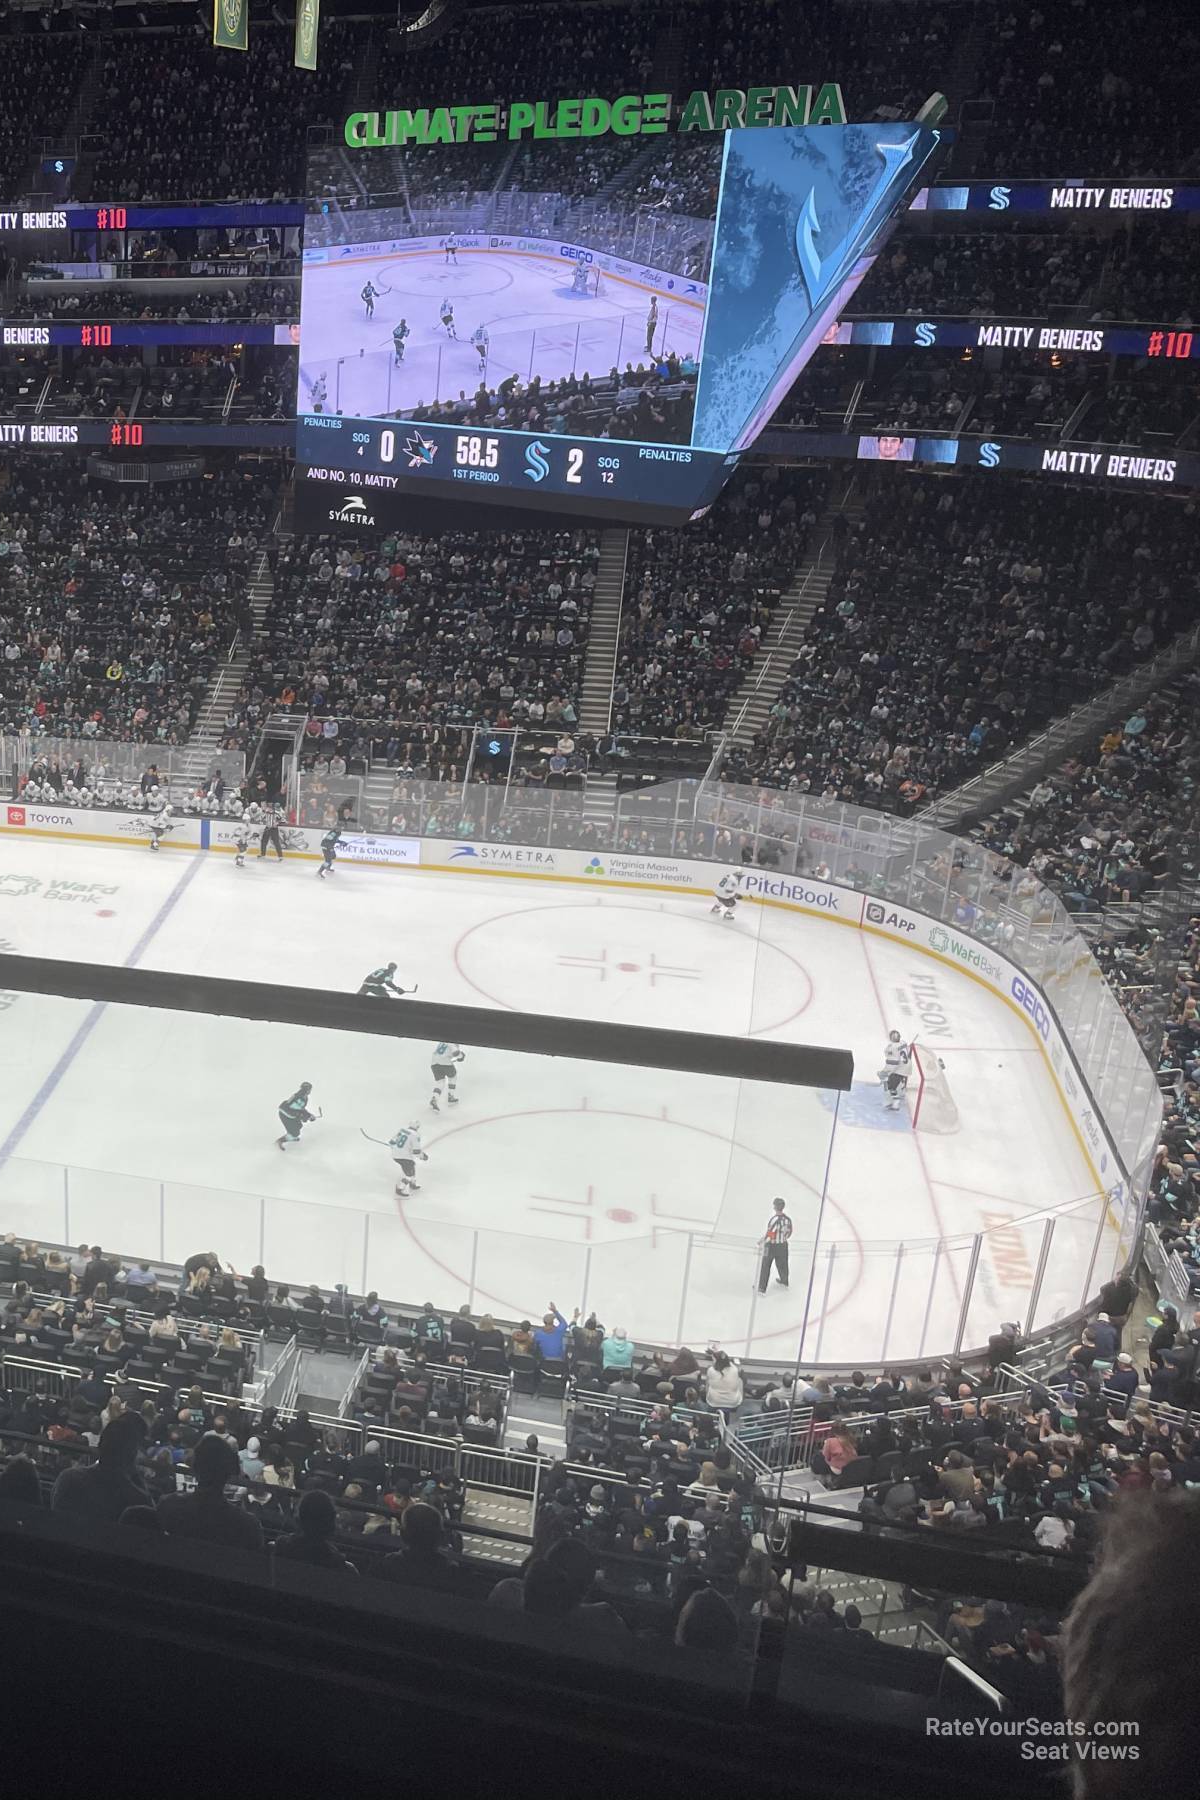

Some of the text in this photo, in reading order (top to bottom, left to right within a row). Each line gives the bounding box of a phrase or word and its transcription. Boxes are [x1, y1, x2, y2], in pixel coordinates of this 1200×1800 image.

[345, 82, 847, 147] CLIMATE PLEDGE ARENA
[1050, 187, 1173, 209] MATTY BENIERS
[22, 211, 67, 229] BENIERS
[96, 208, 127, 229] #10
[560, 245, 593, 264] GEICO
[3, 327, 49, 345] BENIERS
[81, 325, 112, 346] #10
[977, 325, 1192, 358] MATTY BENIERS #10
[303, 417, 342, 429] PENALTIES
[30, 425, 78, 443] BENIERS
[111, 424, 143, 445] #10
[352, 432, 370, 443] SOG
[357, 446, 364, 456] 4
[380, 430, 395, 463] 0
[456, 435, 499, 468] 58.5
[638, 448, 692, 463] PENALTIES
[566, 448, 584, 483] 2
[597, 456, 620, 469] SOG
[1042, 449, 1177, 482] MATTY BENIERS
[307, 467, 399, 488] AND NO. 10, MATTY
[452, 469, 500, 482] 1ST PERIOD
[601, 471, 614, 483] 12
[329, 510, 375, 526] SYMETRA
[29, 813, 73, 826] TOYOTA
[481, 847, 555, 864] SYMETRA
[609, 859, 679, 872] Virginia Mason
[609, 868, 693, 883] Franciscan Health
[49, 879, 120, 895] WaFd
[746, 876, 839, 910] PitchBook
[42, 889, 102, 904] Bank
[1011, 976, 1050, 1040] GEICO
